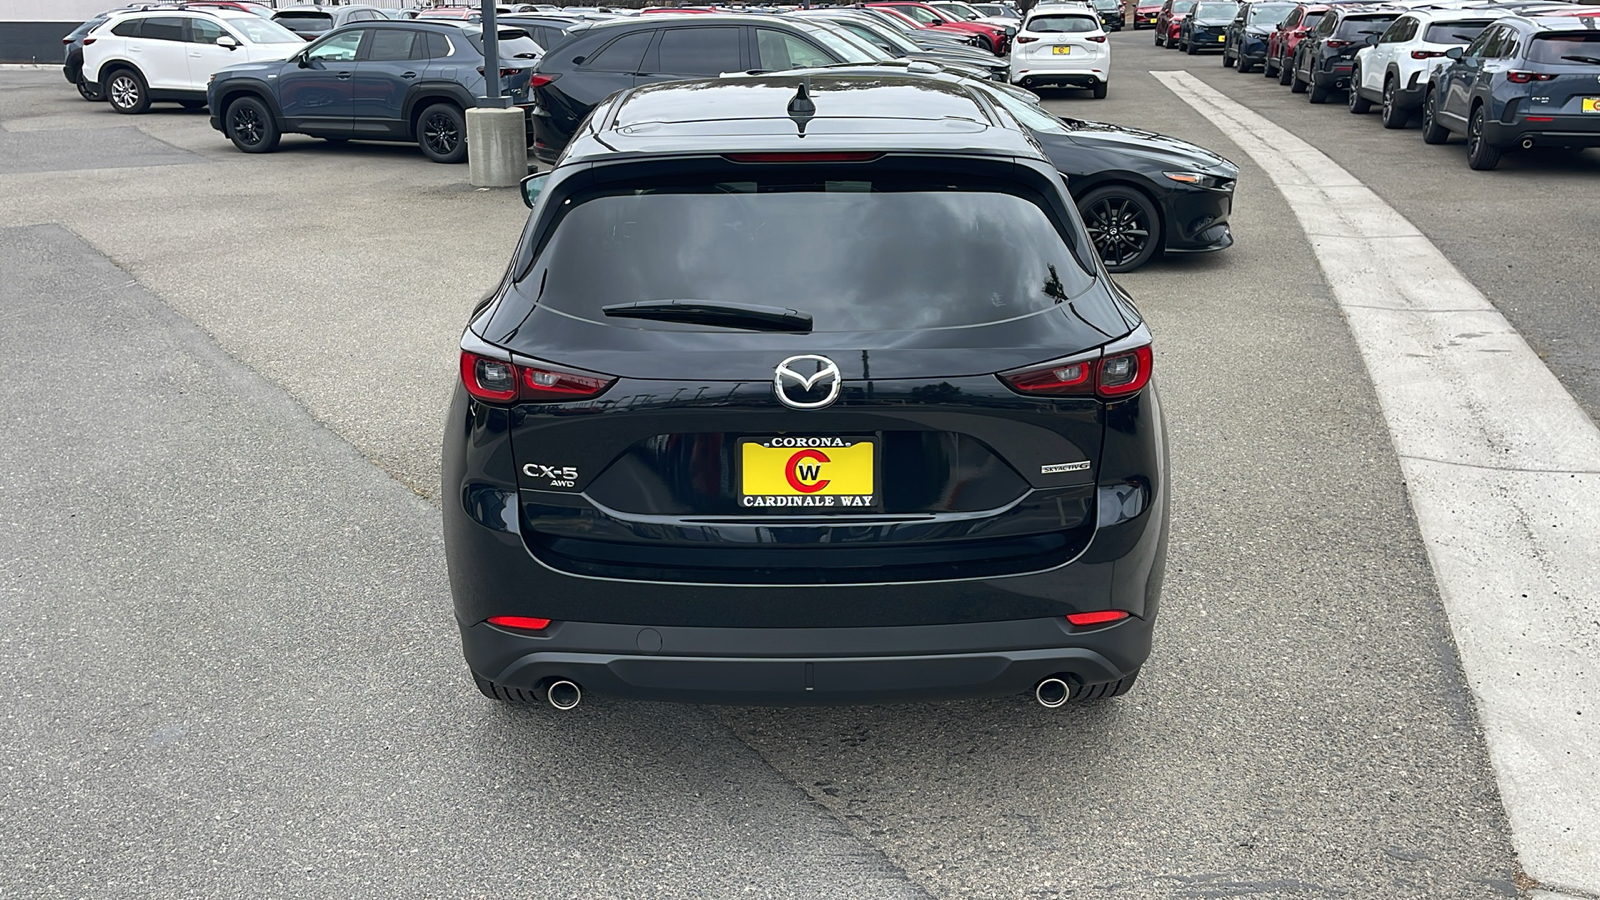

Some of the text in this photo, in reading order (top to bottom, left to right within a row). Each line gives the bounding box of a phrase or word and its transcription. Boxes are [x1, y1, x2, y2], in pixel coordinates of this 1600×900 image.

[771, 437, 844, 447] CORONA
[522, 463, 579, 480] CX-5
[785, 449, 831, 493] C
[798, 463, 821, 481] W
[550, 480, 575, 488] AWD
[743, 496, 873, 507] CARDINALE WAY
